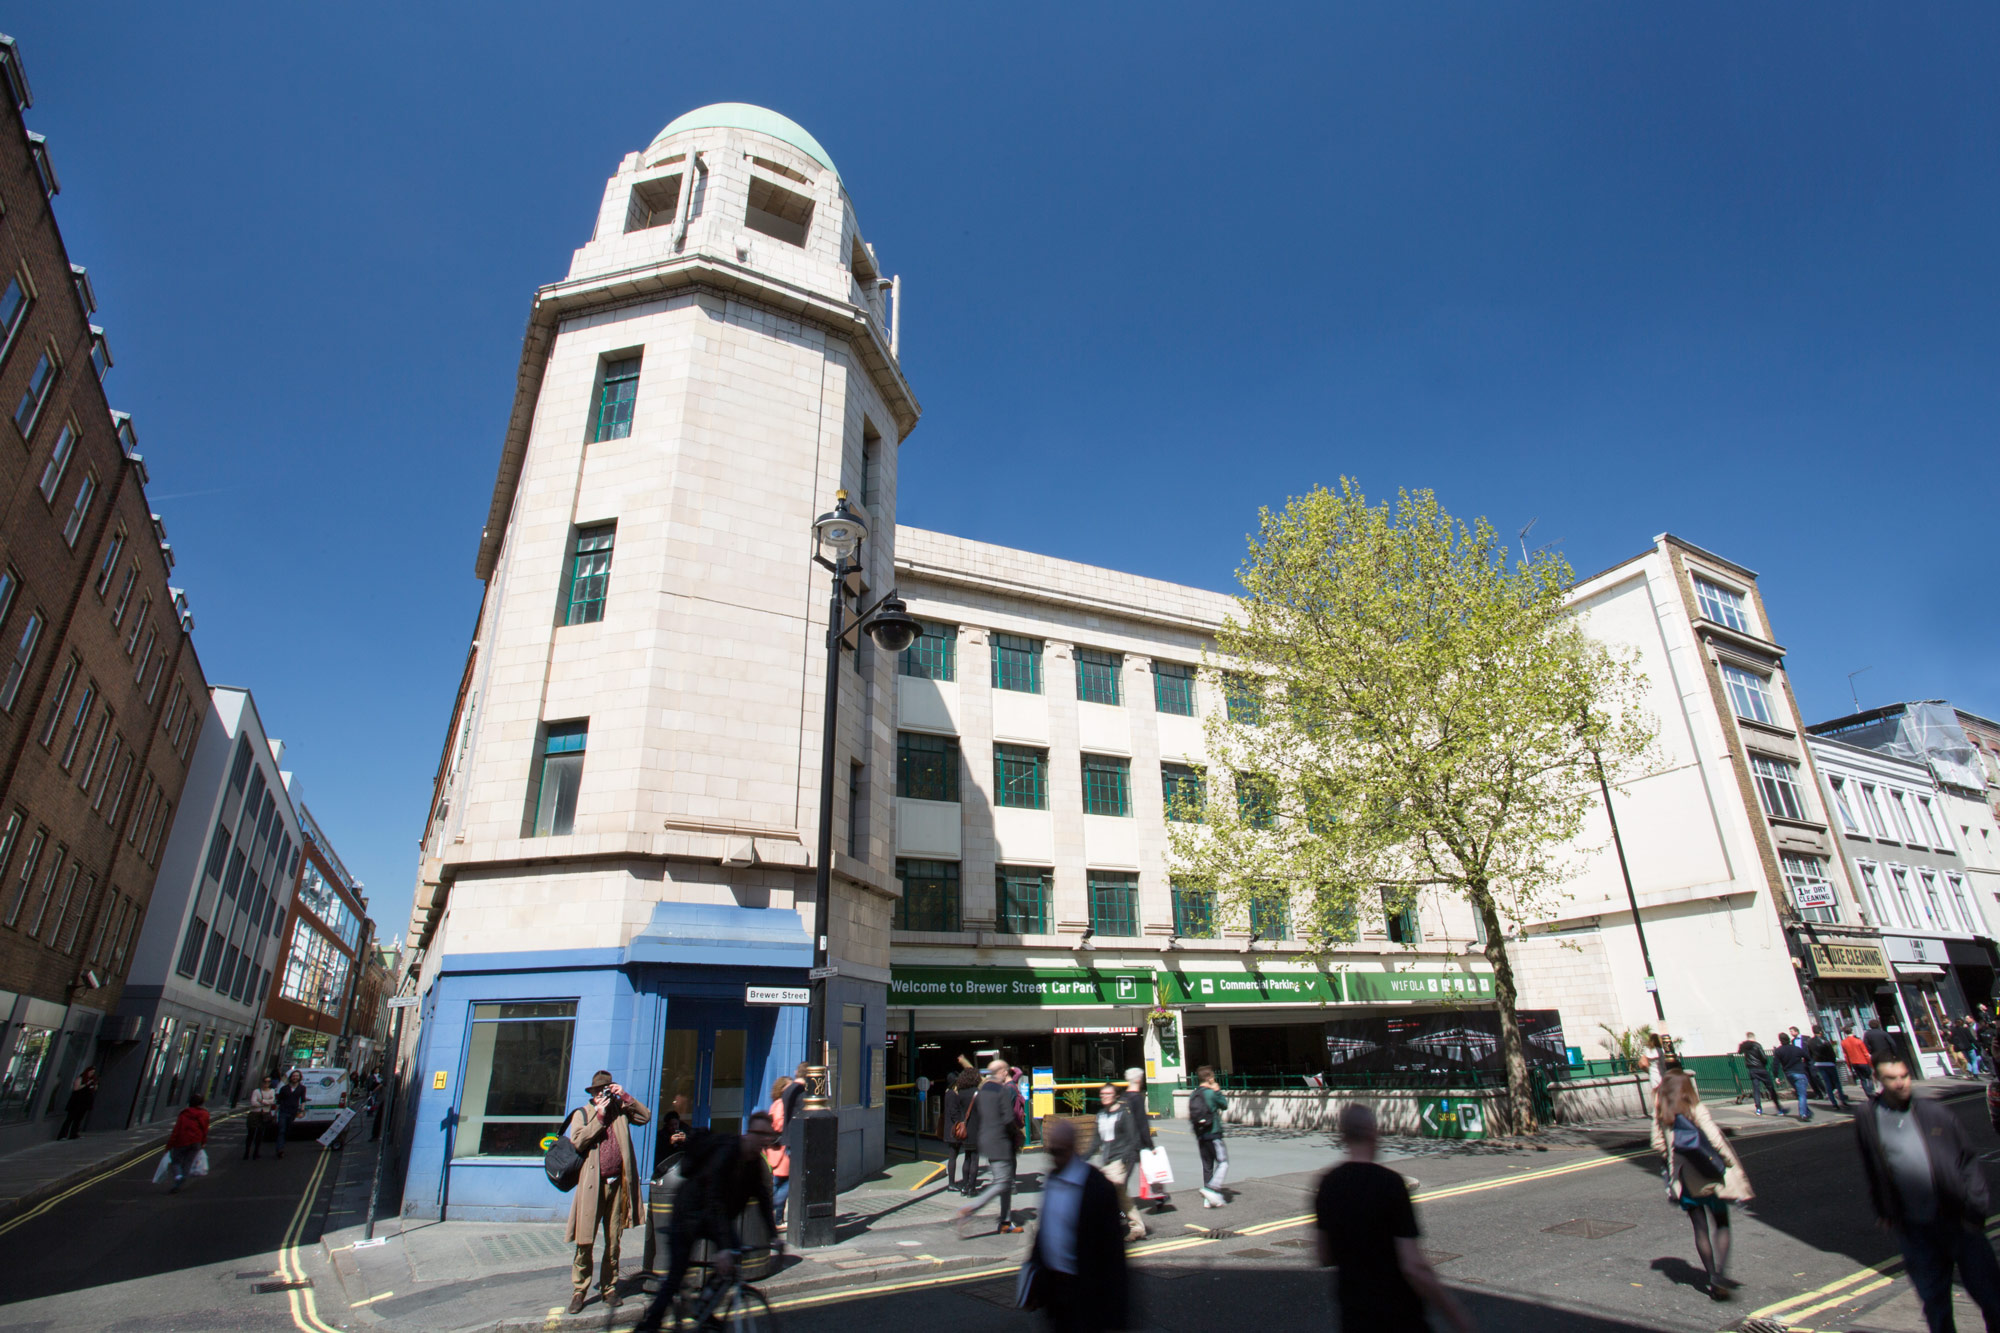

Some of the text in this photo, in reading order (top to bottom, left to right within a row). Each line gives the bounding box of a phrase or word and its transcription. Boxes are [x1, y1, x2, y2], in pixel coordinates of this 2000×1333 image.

[1798, 893, 1830, 902] CLEANING
[1813, 947, 1882, 966] DE UXE CLEANING
[891, 978, 1132, 997] Welcome to Brewer Street Car Park P
[1219, 978, 1300, 993] Commercial Parking
[1390, 980, 1408, 991] W1F
[750, 990, 807, 999] Brewer Street
